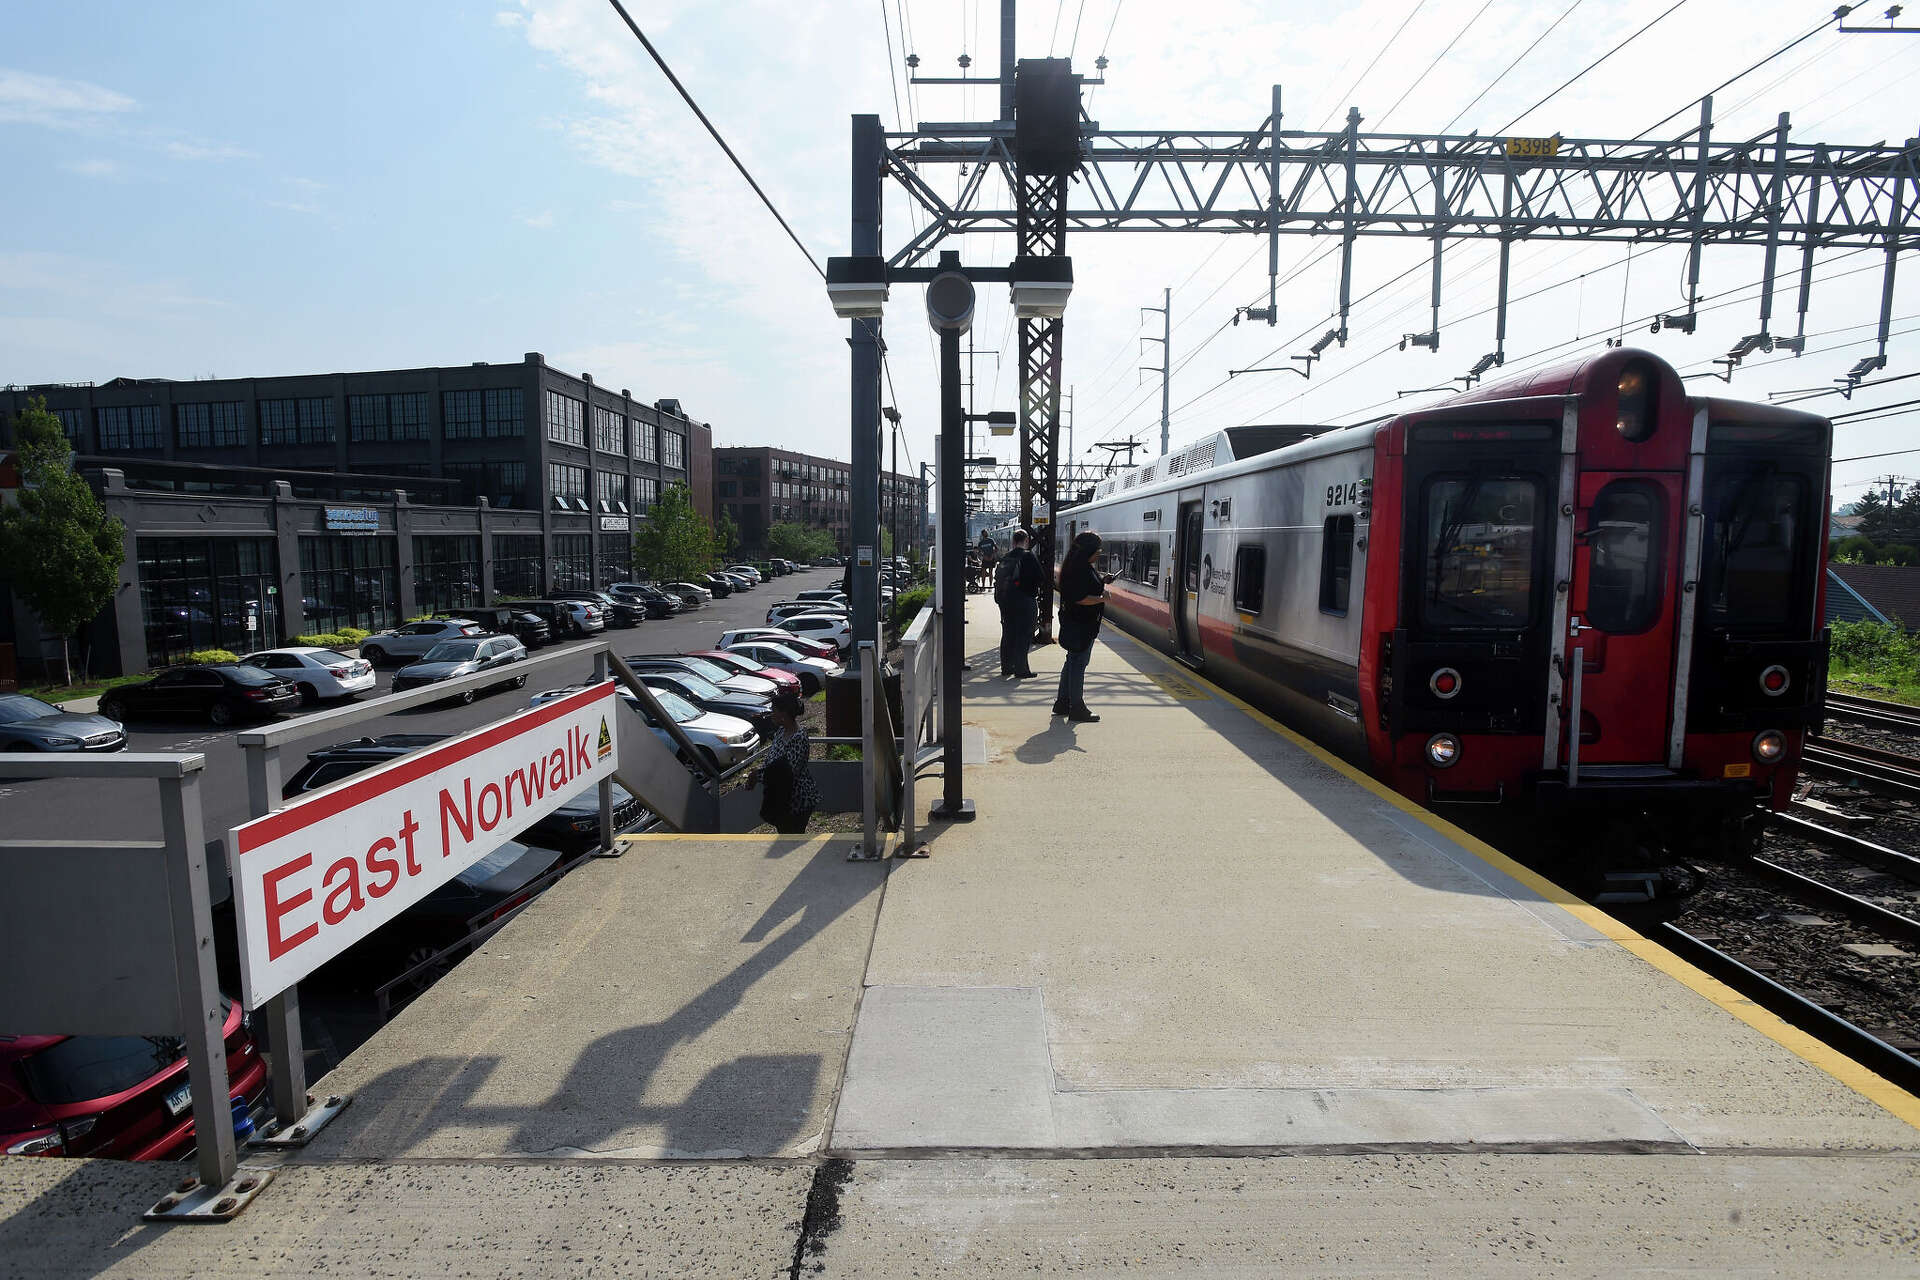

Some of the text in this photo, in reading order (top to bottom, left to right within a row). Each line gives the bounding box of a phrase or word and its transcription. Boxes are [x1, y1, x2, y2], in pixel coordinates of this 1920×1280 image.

[1512, 139, 1551, 154] 539B
[1326, 482, 1357, 506] 9214
[263, 725, 592, 961] East Norwalk
